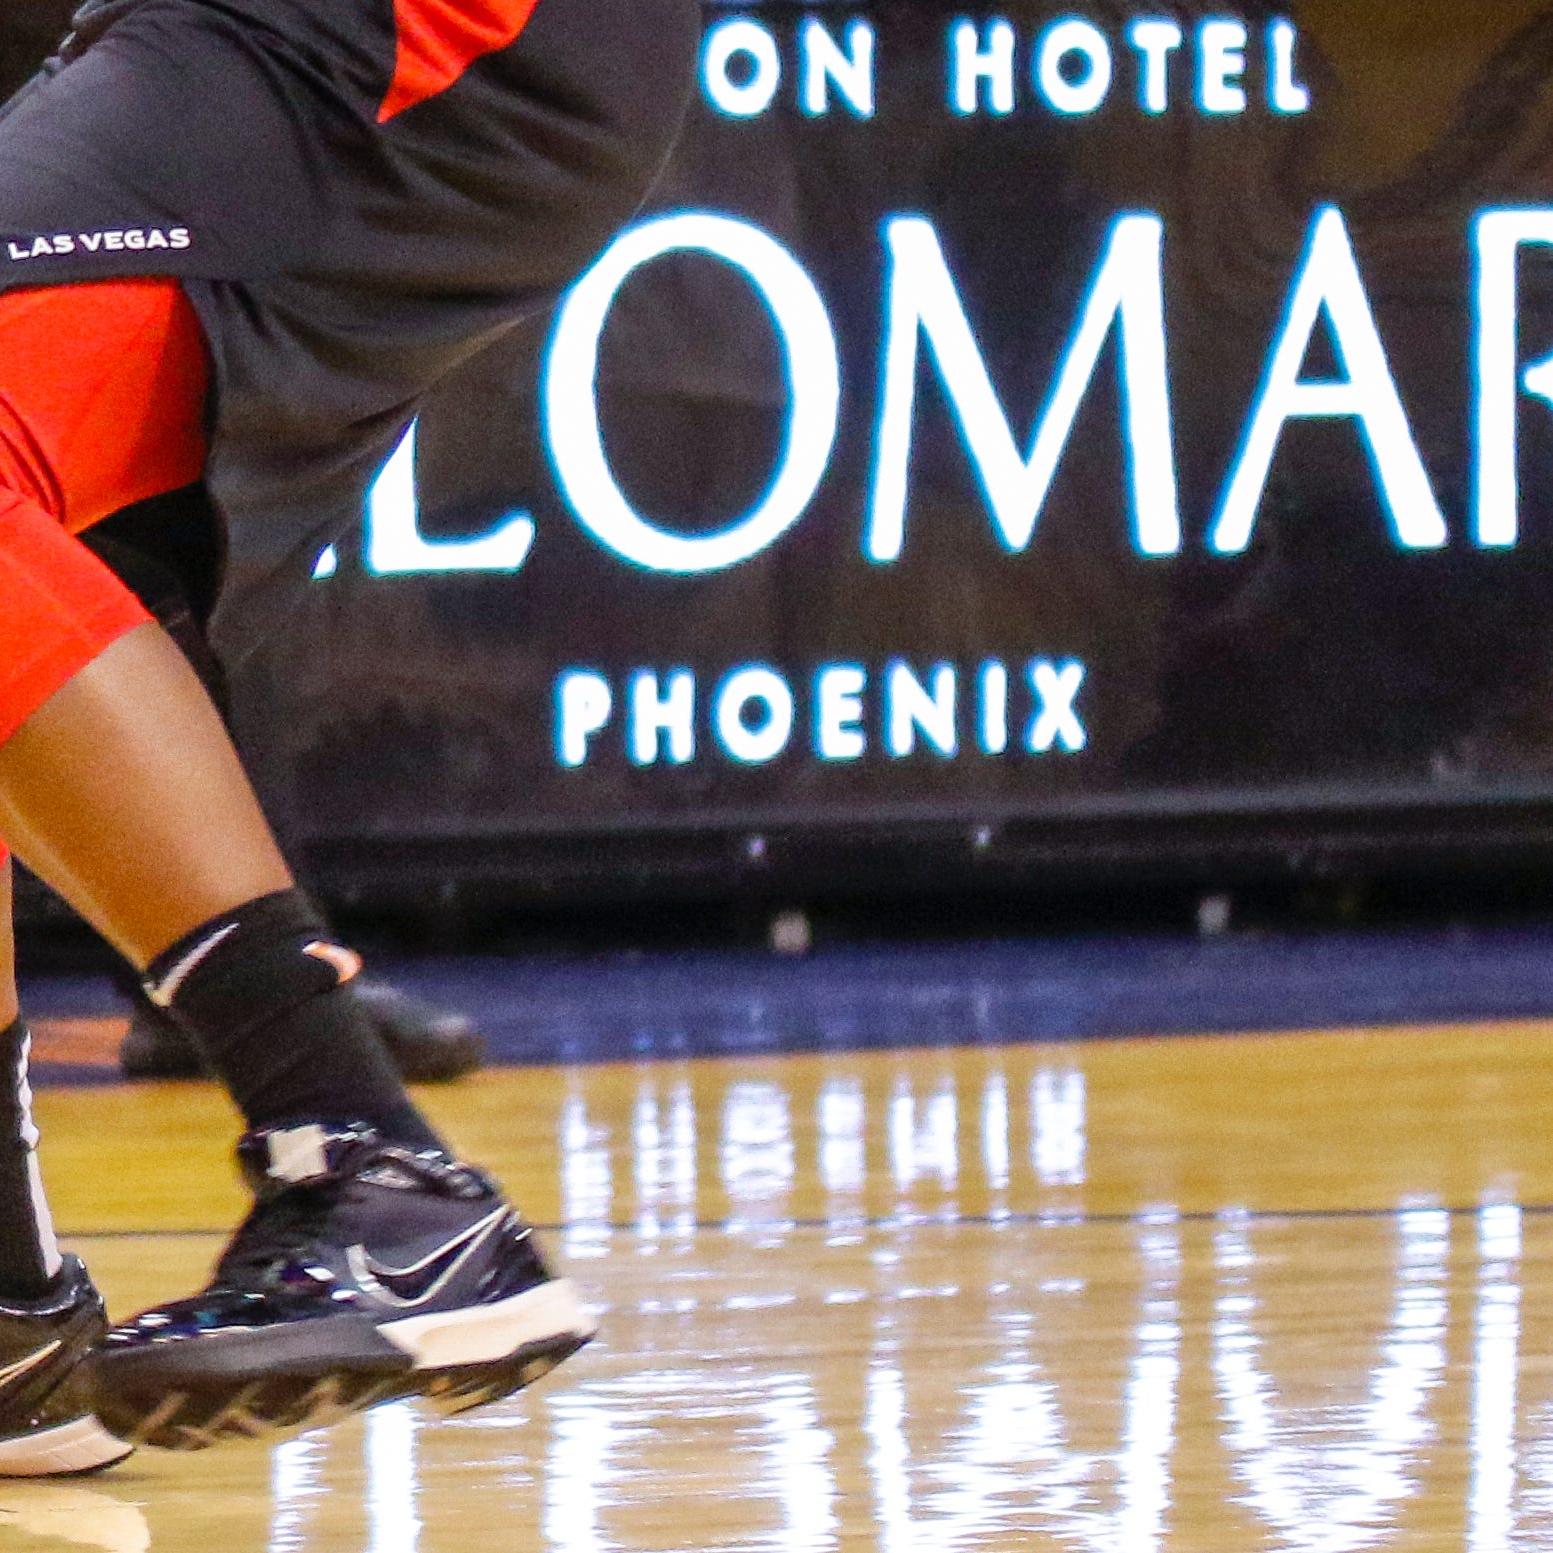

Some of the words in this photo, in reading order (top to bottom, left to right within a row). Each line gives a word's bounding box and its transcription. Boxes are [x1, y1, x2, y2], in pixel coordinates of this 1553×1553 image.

[951, 17, 1310, 116] HOTEL
[7, 233, 75, 261] LAS
[78, 227, 191, 253] VEGAS
[311, 204, 1553, 580] LOMAR
[557, 658, 1088, 768] PHOENIX
